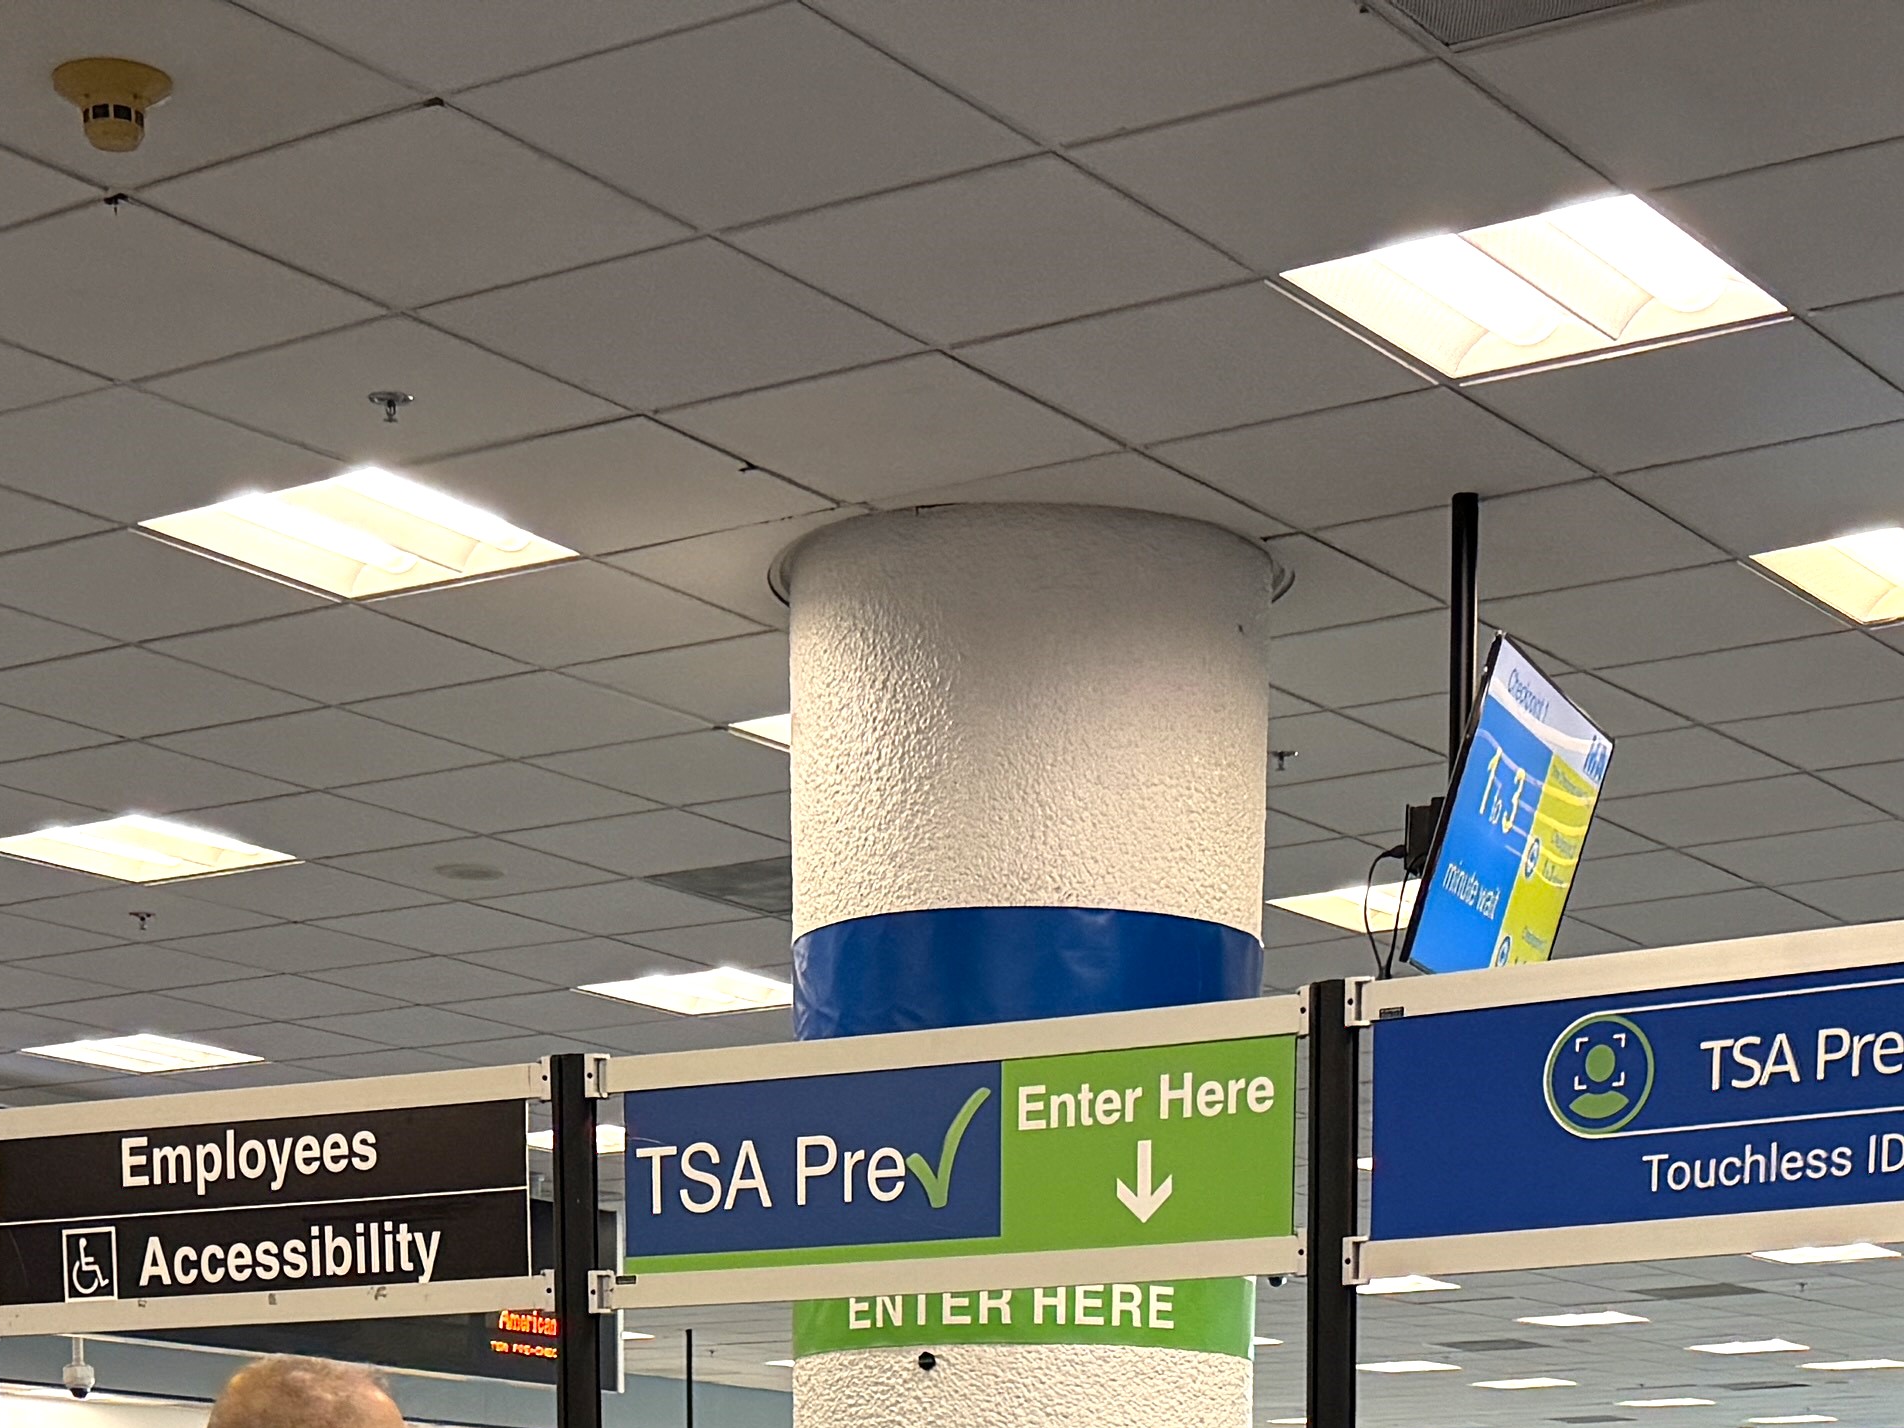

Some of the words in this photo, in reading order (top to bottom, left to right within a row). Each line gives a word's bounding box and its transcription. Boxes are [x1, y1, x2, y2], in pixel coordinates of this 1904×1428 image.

[1479, 748, 1503, 815] 1
[1502, 768, 1526, 833] 3
[1442, 861, 1479, 906] minute
[1476, 883, 1501, 920] wait
[1700, 1032, 1800, 1092] TSA
[1017, 1082, 1144, 1131] Enter
[1160, 1071, 1276, 1121] Here
[121, 1128, 378, 1196] Employees
[635, 1140, 772, 1215] TSA
[795, 1134, 907, 1206] Pre
[1642, 1142, 1852, 1193] Touchless
[138, 1220, 441, 1287] Accessibility
[498, 1310, 558, 1336] American
[849, 1291, 1013, 1331] ENTER
[1033, 1284, 1176, 1330] HERE
